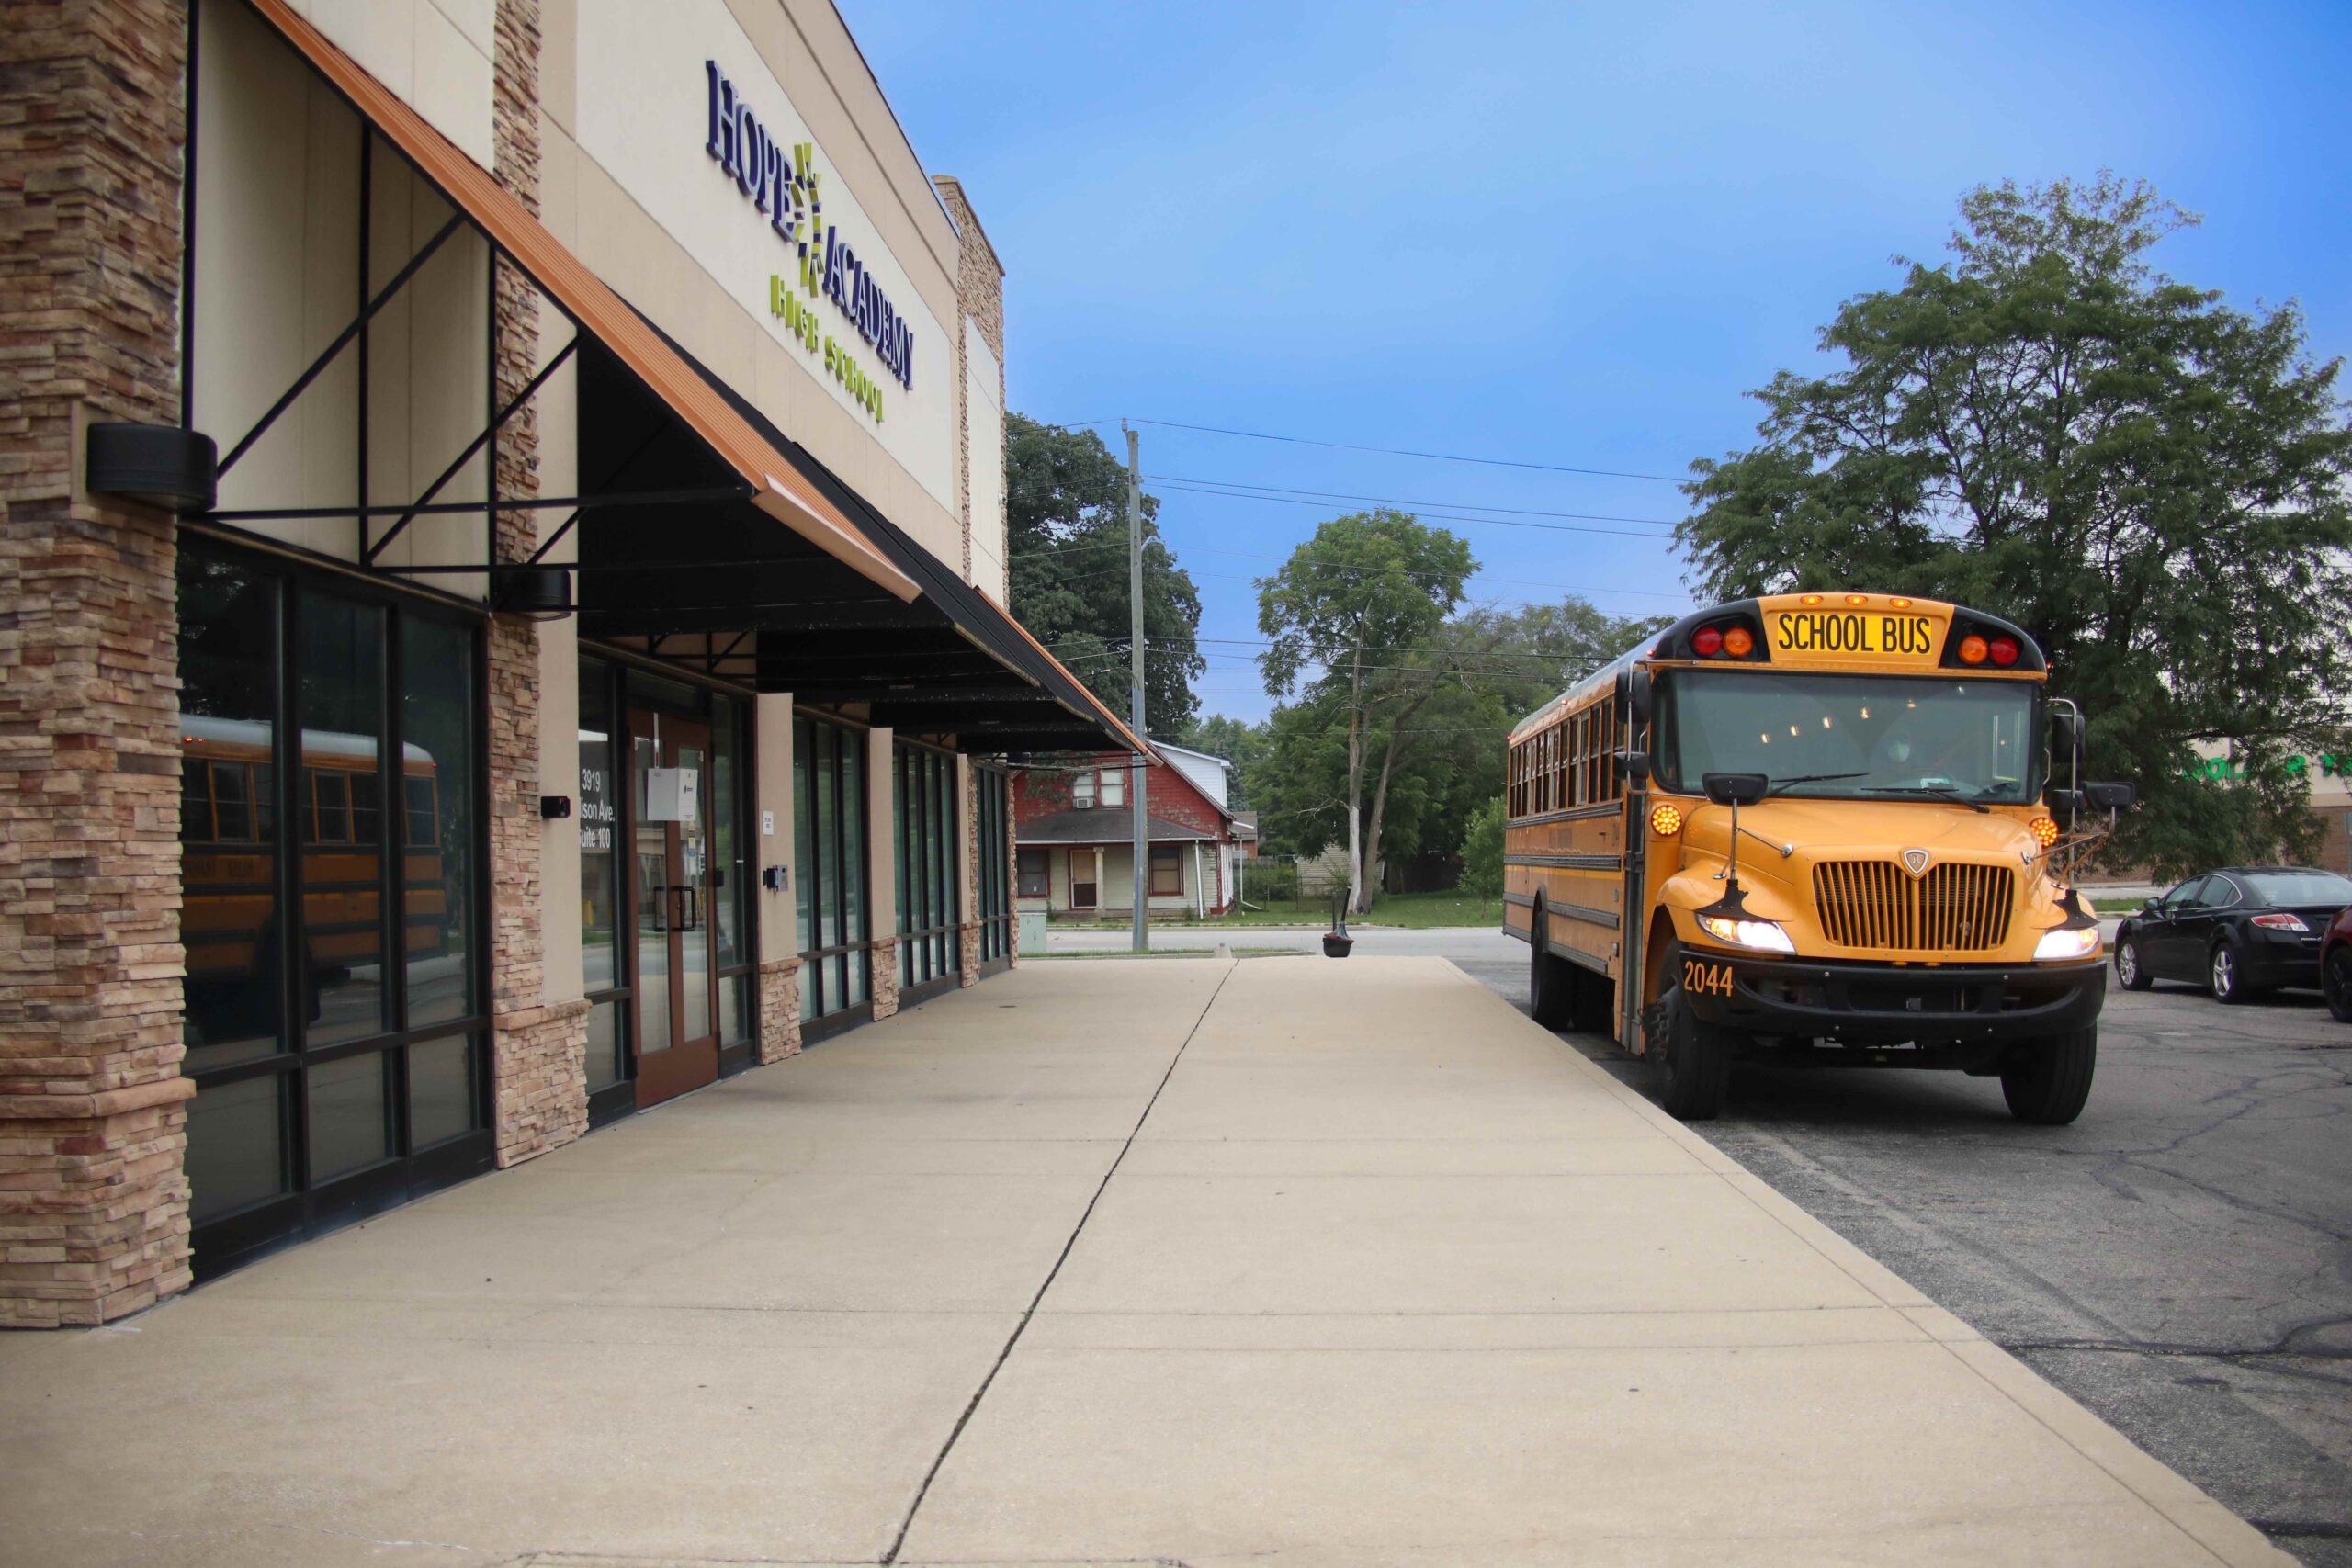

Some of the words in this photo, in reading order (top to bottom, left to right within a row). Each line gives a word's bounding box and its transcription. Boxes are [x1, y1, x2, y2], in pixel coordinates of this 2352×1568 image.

[706, 60, 795, 243] HOPE
[822, 225, 914, 390] ACADEMY
[770, 275, 819, 353] HIGH
[824, 335, 885, 423] SCHOOL
[1778, 613, 1874, 651] SCHOOL
[1882, 616, 1931, 654] BUS
[582, 768, 601, 792] 3919
[598, 798, 616, 822] Ave.
[580, 826, 596, 848] uite
[597, 827, 611, 849] 100
[1683, 960, 1734, 998] 2044
